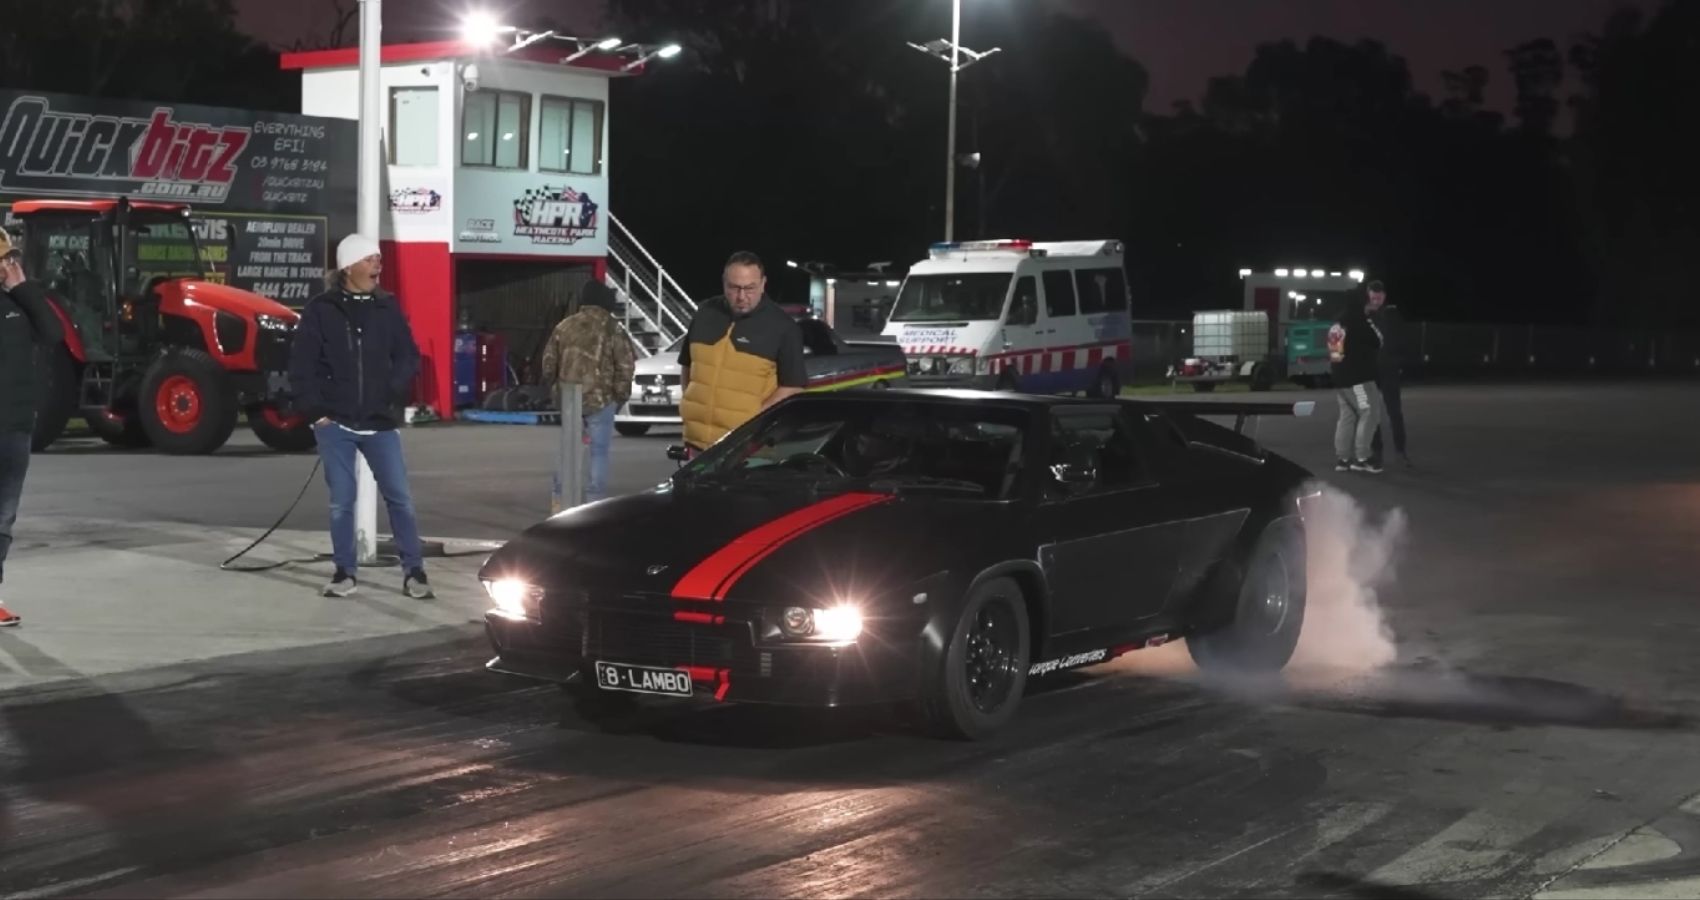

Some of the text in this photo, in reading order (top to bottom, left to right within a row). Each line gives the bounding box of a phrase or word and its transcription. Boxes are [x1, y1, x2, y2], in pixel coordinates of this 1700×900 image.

[254, 121, 325, 139] EVERYTHING
[274, 137, 305, 153] EFI!
[251, 156, 268, 168] 03
[271, 157, 300, 170] 9768
[132, 181, 225, 197] .com.au
[530, 200, 583, 226] HPR
[246, 221, 316, 234] AEROFLOW DEALER
[515, 226, 596, 238] HEATHCOTE PARK
[282, 237, 305, 249] DRIVE
[533, 236, 577, 245] RACEWAY
[249, 251, 312, 264] FROM THE TRACK
[237, 265, 263, 278] LARGE
[264, 266, 289, 278] RANGE
[289, 267, 298, 278] IN
[299, 267, 324, 279] STOCK
[280, 282, 310, 299] 2774
[903, 329, 957, 337] MEDICAL
[900, 336, 957, 344] SUPPORT
